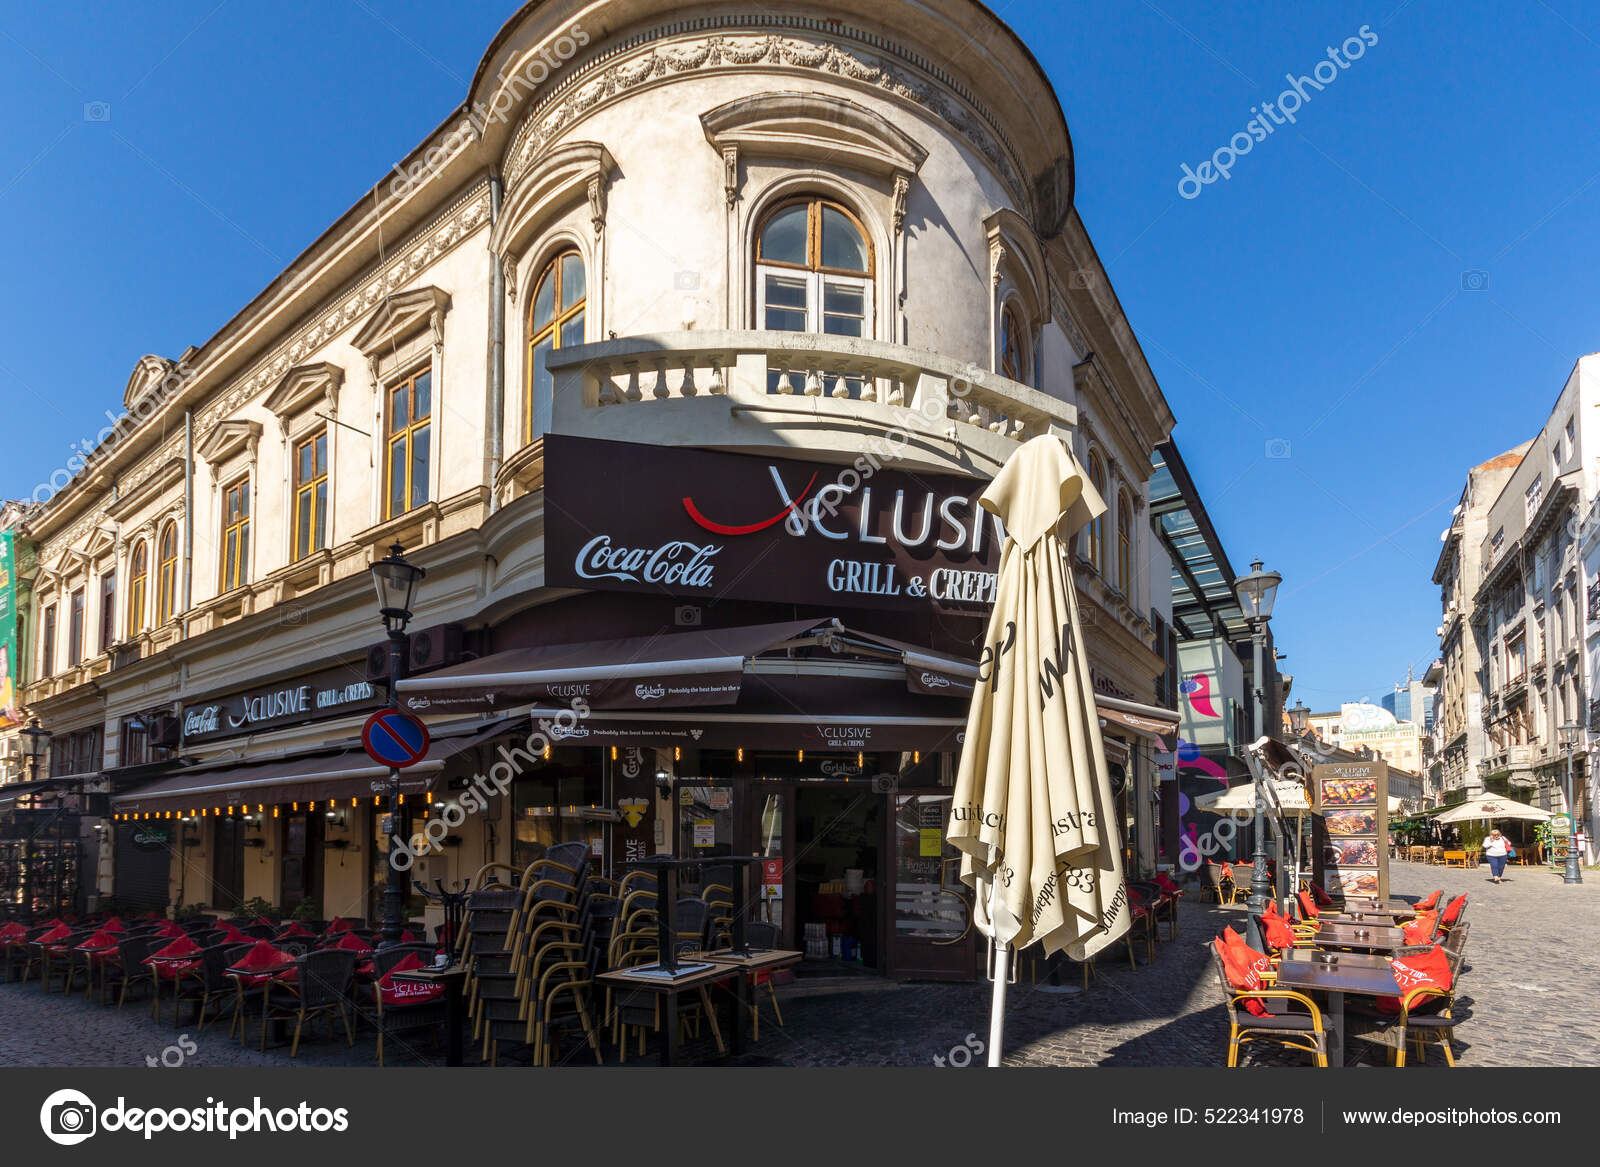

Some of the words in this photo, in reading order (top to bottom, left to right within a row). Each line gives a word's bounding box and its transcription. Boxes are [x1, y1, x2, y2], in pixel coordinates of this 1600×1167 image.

[575, 535, 724, 588] Coca-Cola
[827, 559, 900, 595] GRILL
[906, 575, 926, 597] &
[635, 684, 665, 699] Carlsberg
[921, 672, 950, 688] Carlsberg
[228, 685, 312, 727] XCLUSIVE
[317, 689, 337, 708] GRILL
[184, 706, 220, 736] Coca-Cola
[551, 724, 590, 738] Carlsberg
